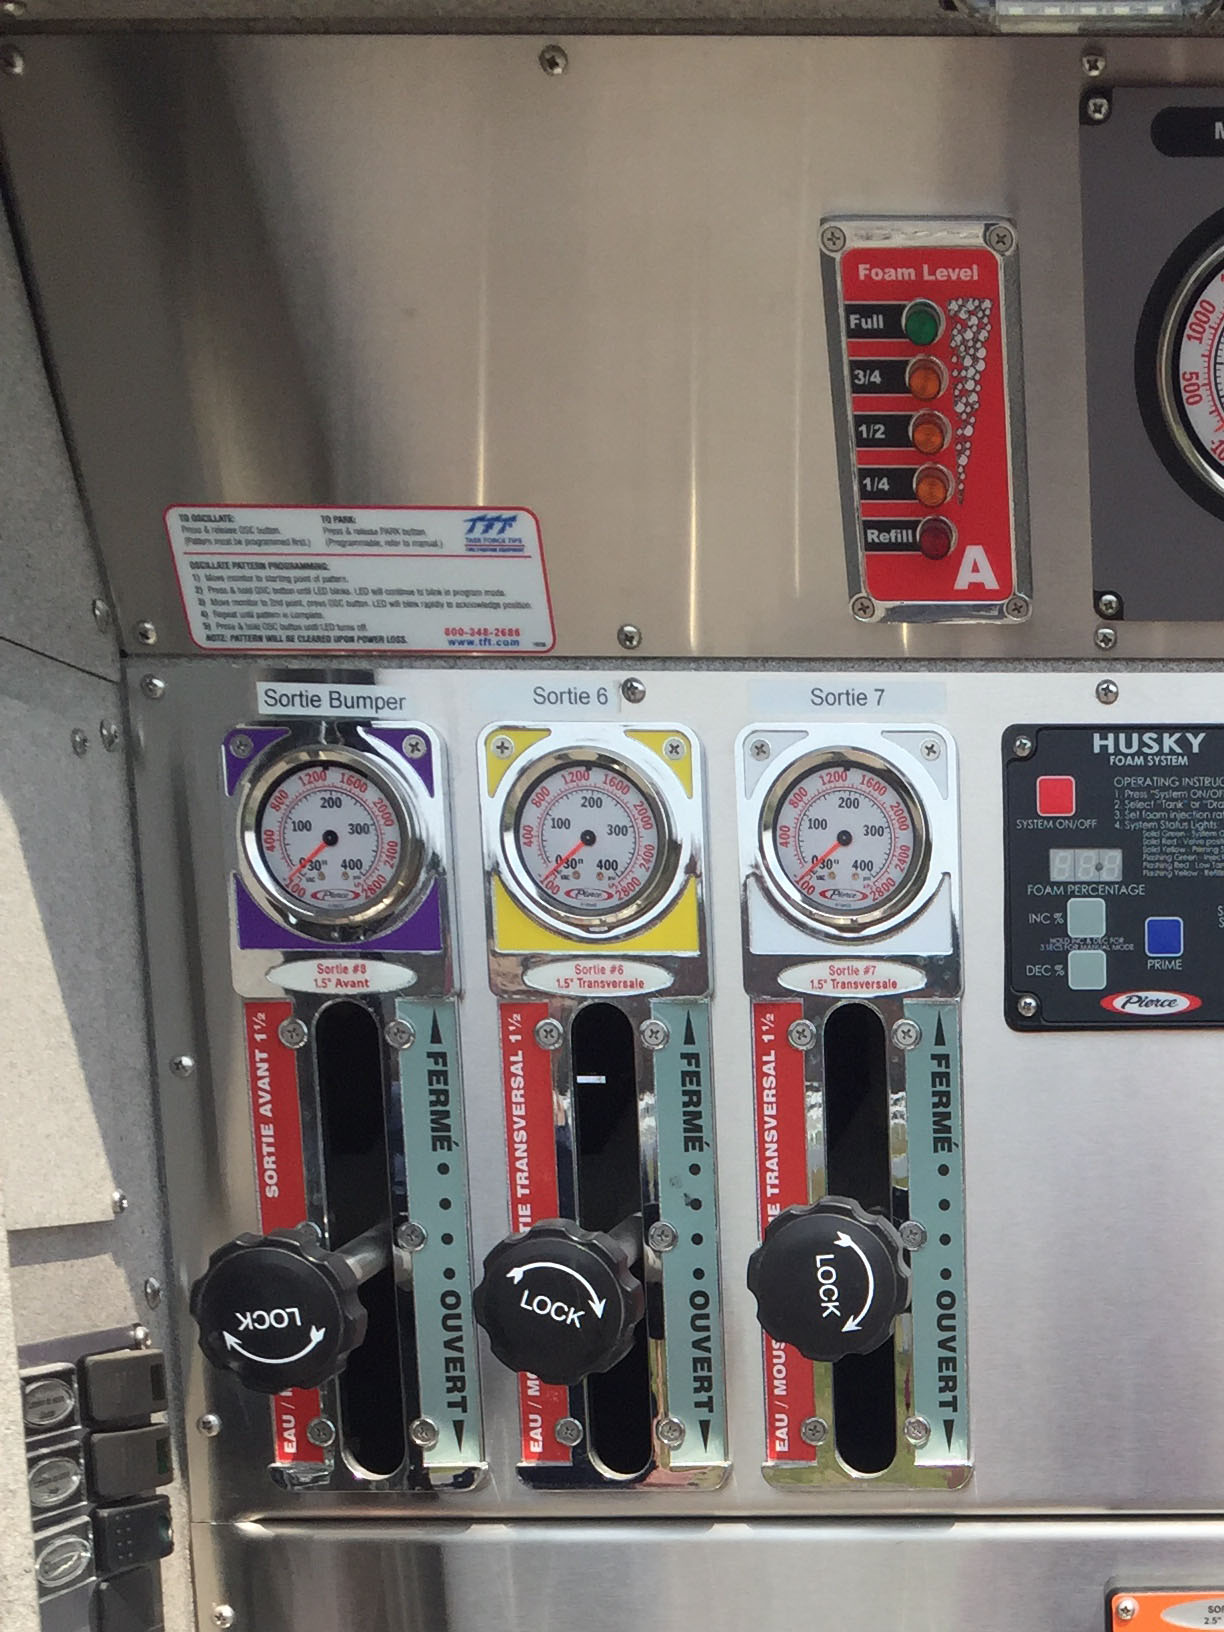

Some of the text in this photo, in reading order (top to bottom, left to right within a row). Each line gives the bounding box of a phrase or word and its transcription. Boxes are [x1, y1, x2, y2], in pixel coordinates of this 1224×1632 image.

[858, 264, 979, 281] Foam Level
[850, 314, 884, 329] Full
[854, 369, 881, 385] 3/4
[858, 423, 885, 439] 1/2
[863, 477, 889, 492] 1/4
[867, 529, 913, 544] Refill
[445, 628, 520, 637] 800-348-2686
[448, 638, 519, 646] www.tft.com
[264, 688, 406, 711] Sortie Bumper
[533, 687, 608, 706] Sortie 6
[811, 689, 884, 706] Sortie 7
[1093, 733, 1206, 753] HUSKY
[1110, 756, 1188, 766] FOAM SYSTEM
[1114, 777, 1179, 787] OPERATING
[1017, 820, 1097, 829] SYSTEM ON/OFF
[1028, 885, 1145, 895] FOAM PERCENTAGE
[317, 964, 350, 975] Sortie
[575, 964, 624, 975] Sortie #6
[829, 964, 876, 976] Sortie #7
[1148, 960, 1182, 970] PRIME
[334, 977, 370, 989] Avant
[577, 978, 644, 988] Transversale
[832, 978, 897, 991] Transversale
[426, 1052, 459, 1152] FERMÉ
[680, 1052, 710, 1153] FERMÉ
[930, 1054, 959, 1153] FERMÉ
[255, 1049, 278, 1198] SORTIE AVANT
[511, 1051, 530, 1196] TRANSVERSAL
[762, 1050, 779, 1197] TRANSVERSAL
[815, 1255, 841, 1317] LOCK
[520, 1290, 585, 1328] LOCK
[238, 1307, 301, 1331] LOCK
[440, 1290, 467, 1414] OUVERT
[689, 1290, 714, 1413] OUVERT
[936, 1290, 958, 1413] OUVERT
